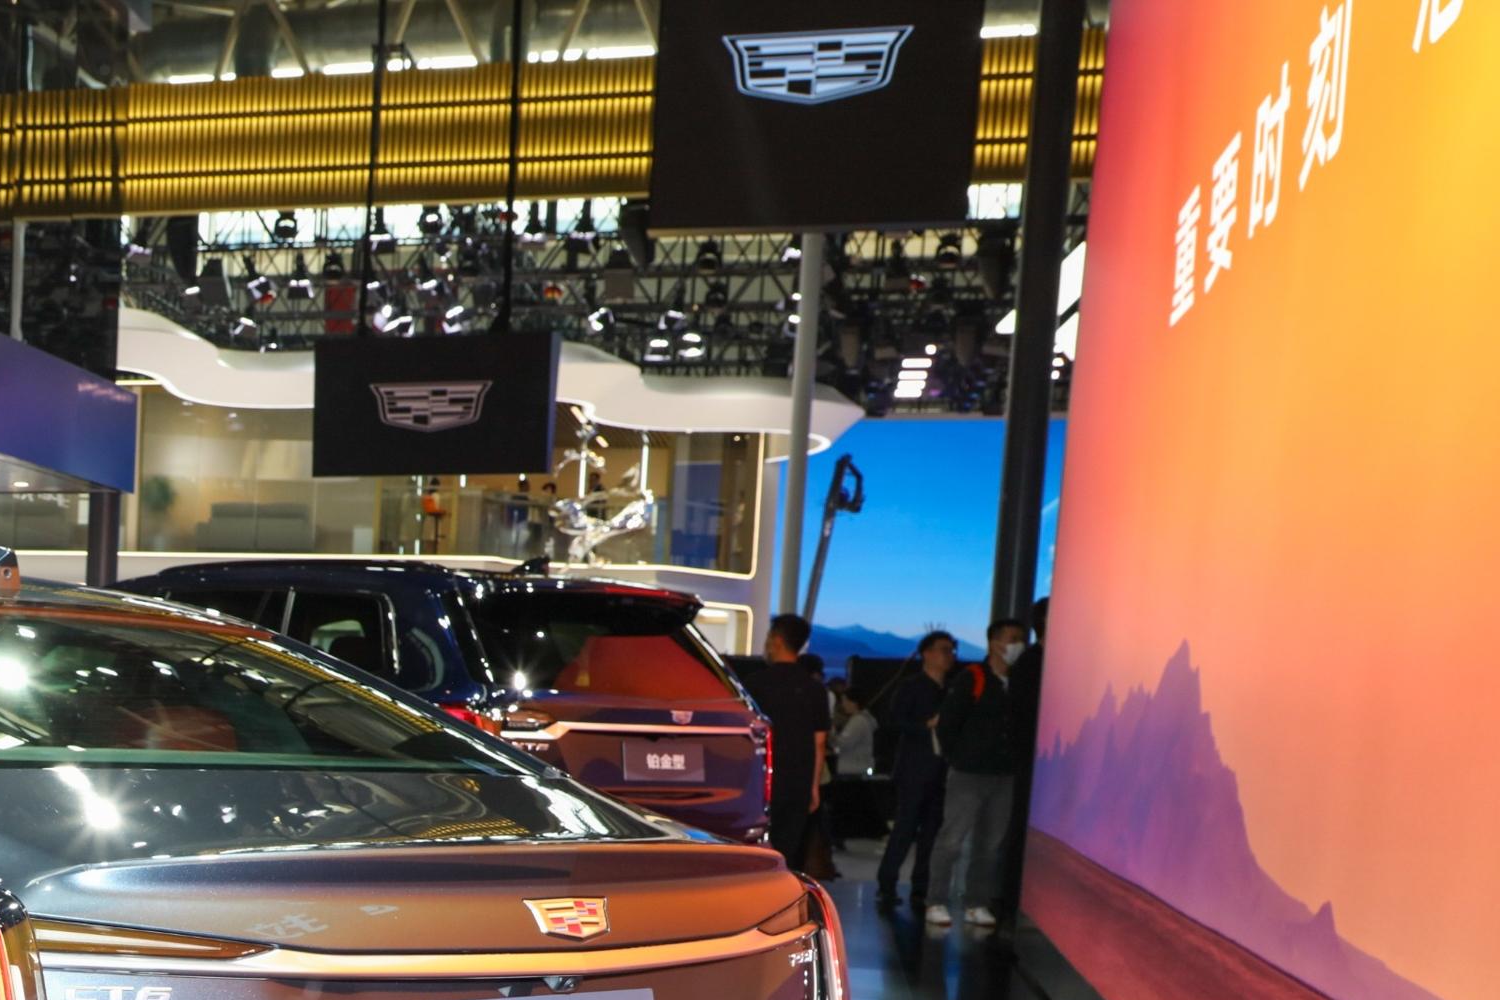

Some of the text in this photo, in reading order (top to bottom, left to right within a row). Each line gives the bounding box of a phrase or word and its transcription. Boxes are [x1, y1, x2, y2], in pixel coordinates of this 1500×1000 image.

[1169, 0, 1352, 327] 重要时刻
[646, 753, 686, 770] 铂金型
